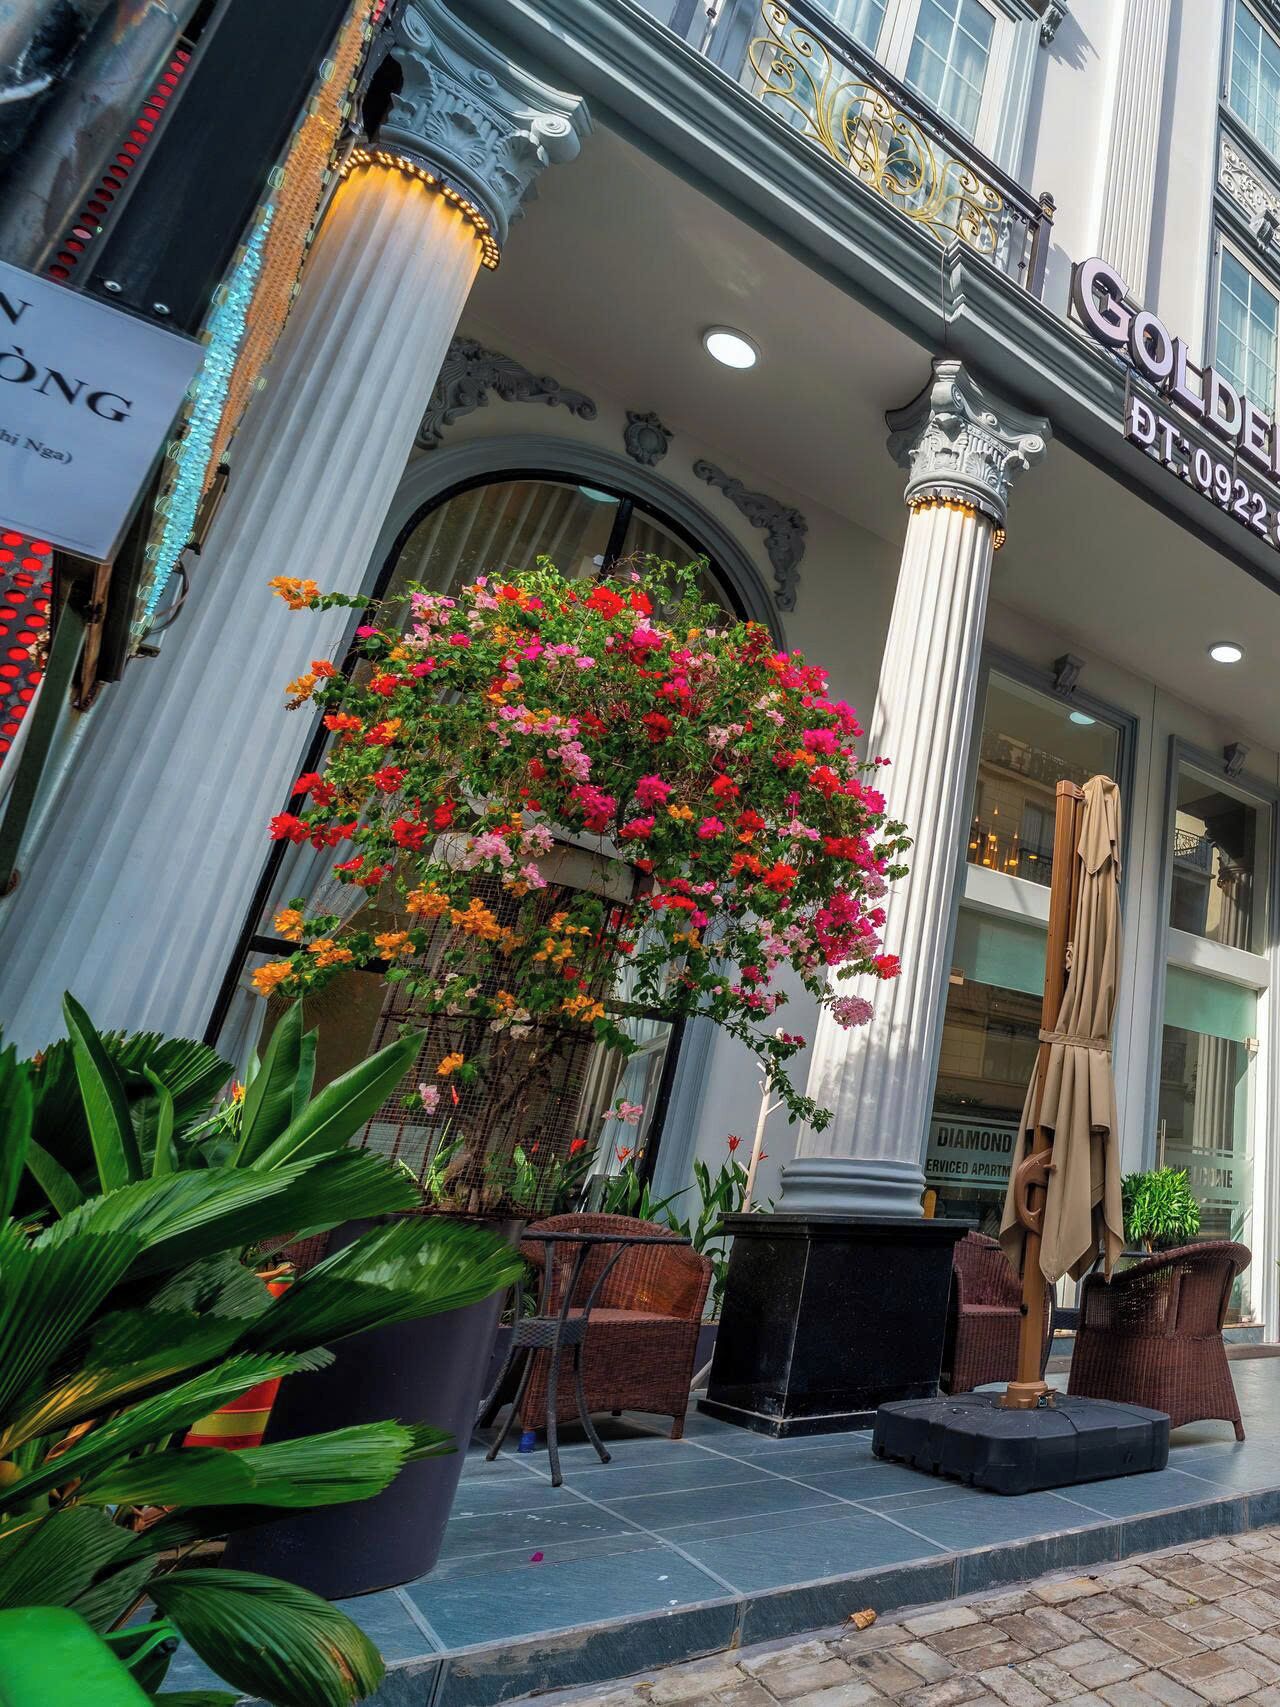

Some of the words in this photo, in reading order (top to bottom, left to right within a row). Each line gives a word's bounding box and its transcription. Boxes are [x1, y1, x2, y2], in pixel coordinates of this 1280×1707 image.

[23, 437, 73, 465] Nga)
[938, 1127, 1013, 1154] DIAMOND
[926, 1159, 969, 1174] ERVICED
[971, 1162, 1012, 1178] APARTM
